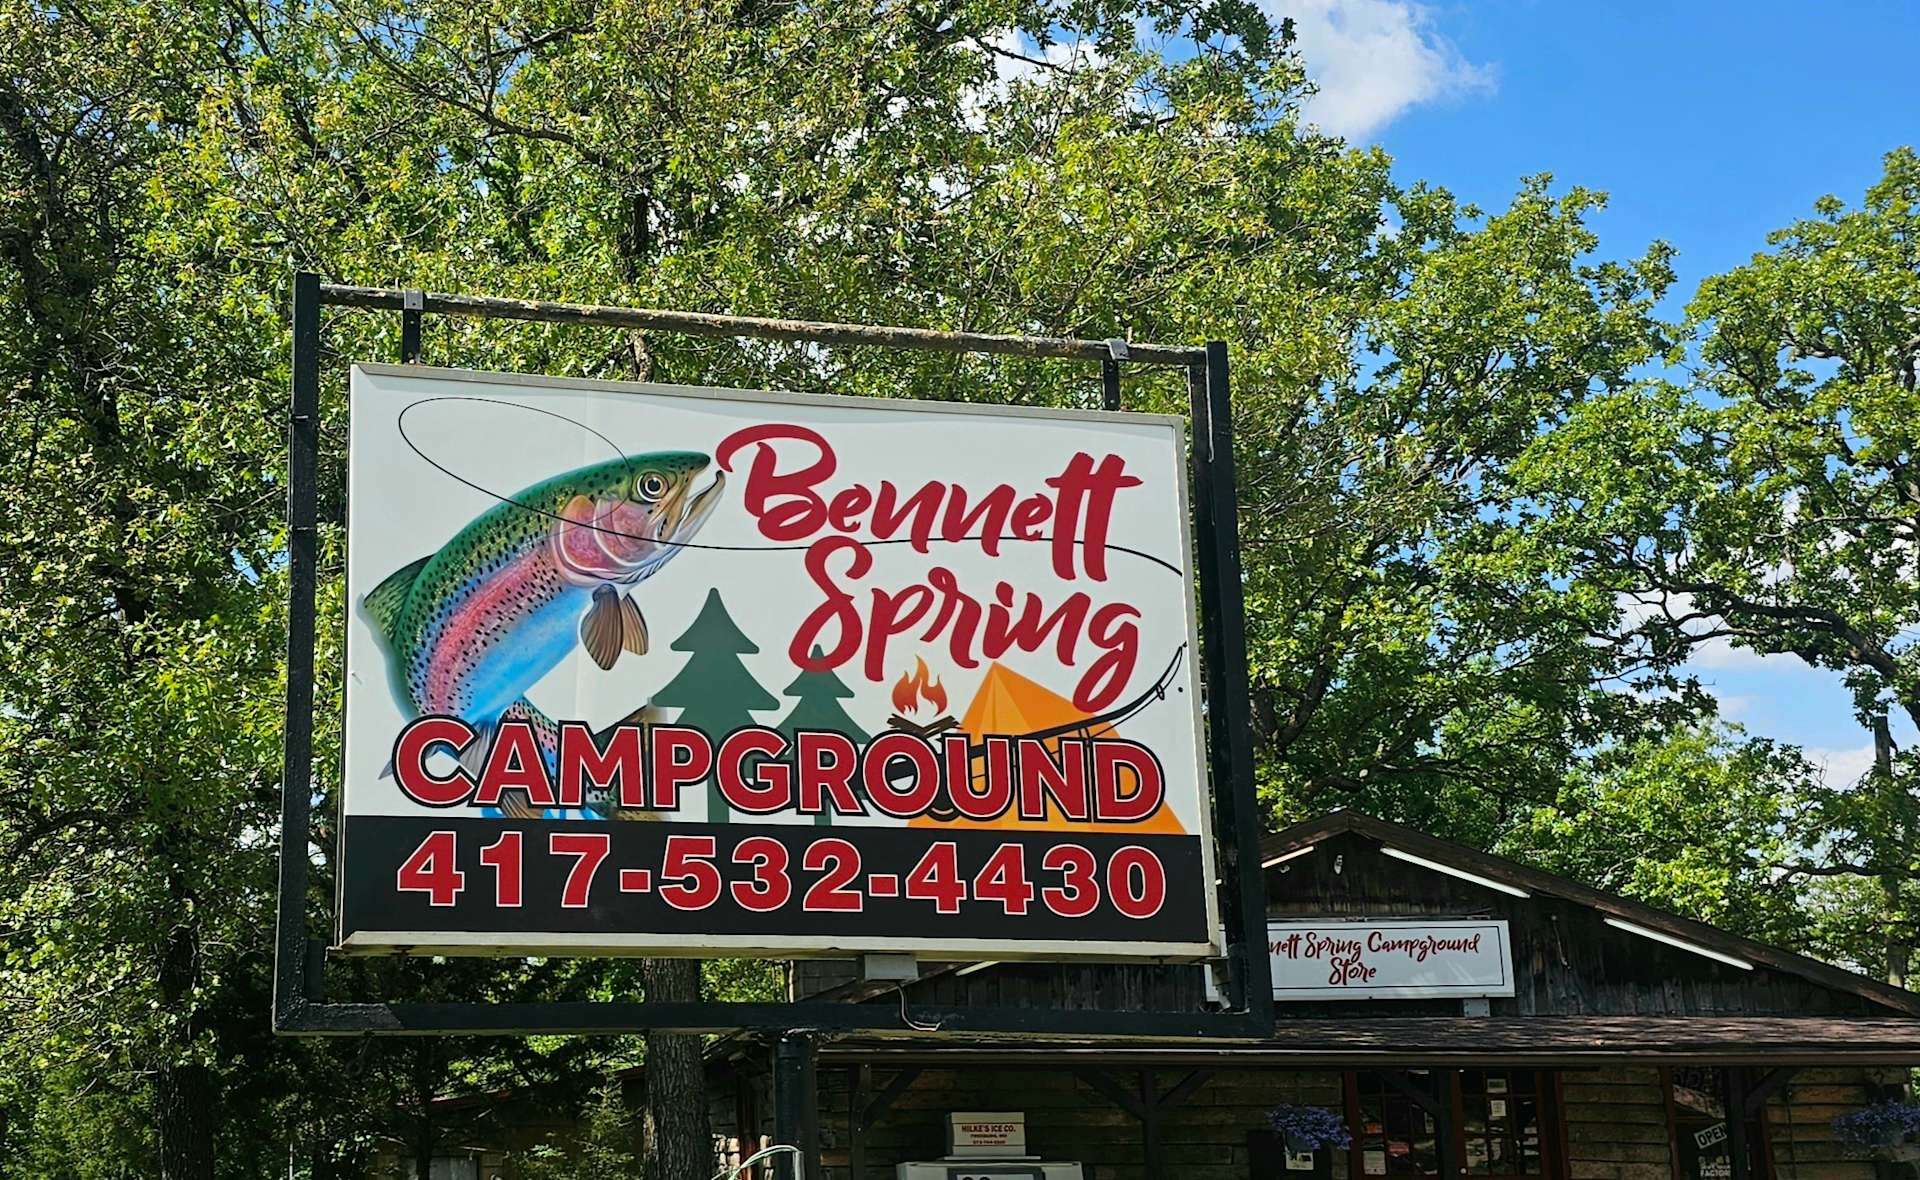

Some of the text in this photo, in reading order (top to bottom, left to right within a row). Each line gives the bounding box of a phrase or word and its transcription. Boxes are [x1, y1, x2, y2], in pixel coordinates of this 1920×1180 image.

[715, 423, 1143, 582] Bennett
[788, 535, 1142, 712] Spring
[392, 715, 1166, 823] CAMPGROUND
[397, 830, 1166, 919] 417-532-4430
[1269, 931, 1480, 963] nett Spring Campground
[1328, 957, 1377, 986] Store
[991, 1125, 1003, 1133] ICE
[1698, 1124, 1727, 1146] OPEN
